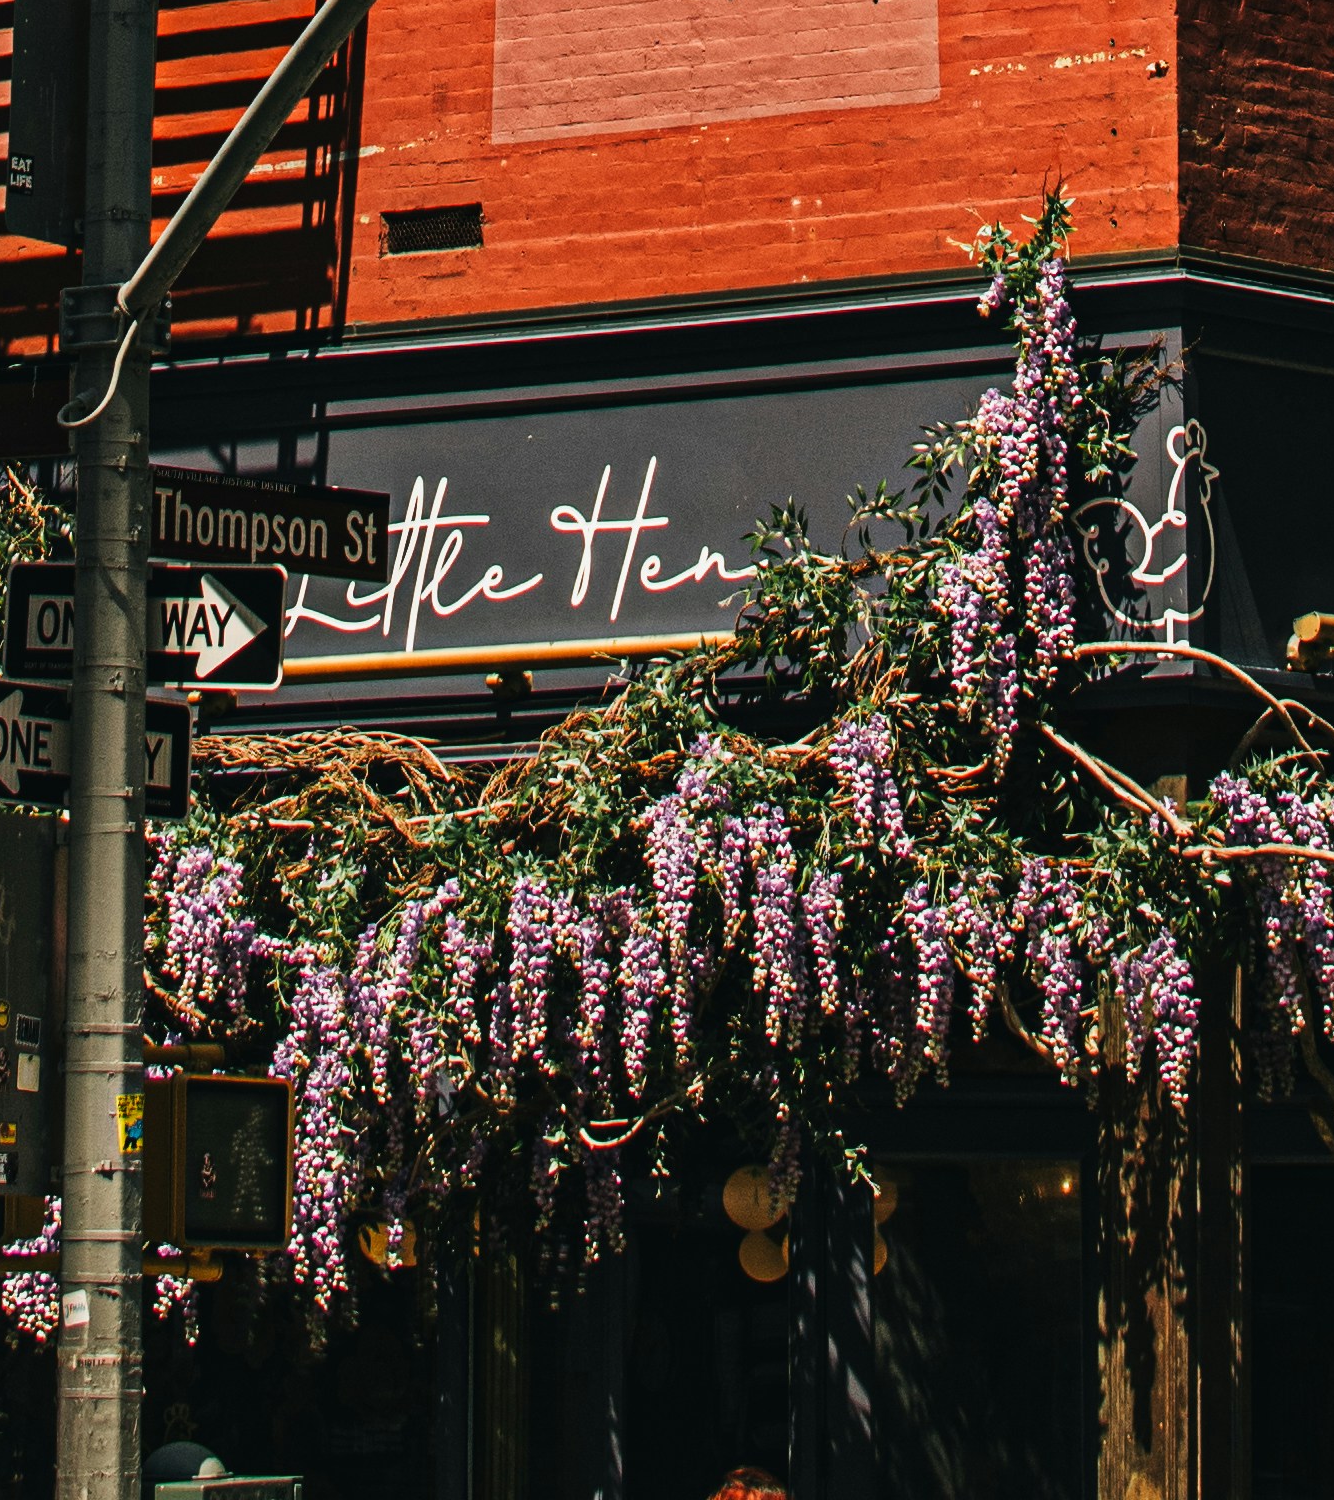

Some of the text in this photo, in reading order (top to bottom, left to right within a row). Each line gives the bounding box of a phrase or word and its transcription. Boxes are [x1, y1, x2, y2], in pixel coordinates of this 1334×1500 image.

[11, 156, 32, 172] EAT
[156, 467, 298, 494] SOUTH VILLAGE HISTORIC DISTRICT
[155, 486, 378, 566] Thompson St
[550, 455, 769, 623] Hen
[161, 602, 237, 648] WAY
